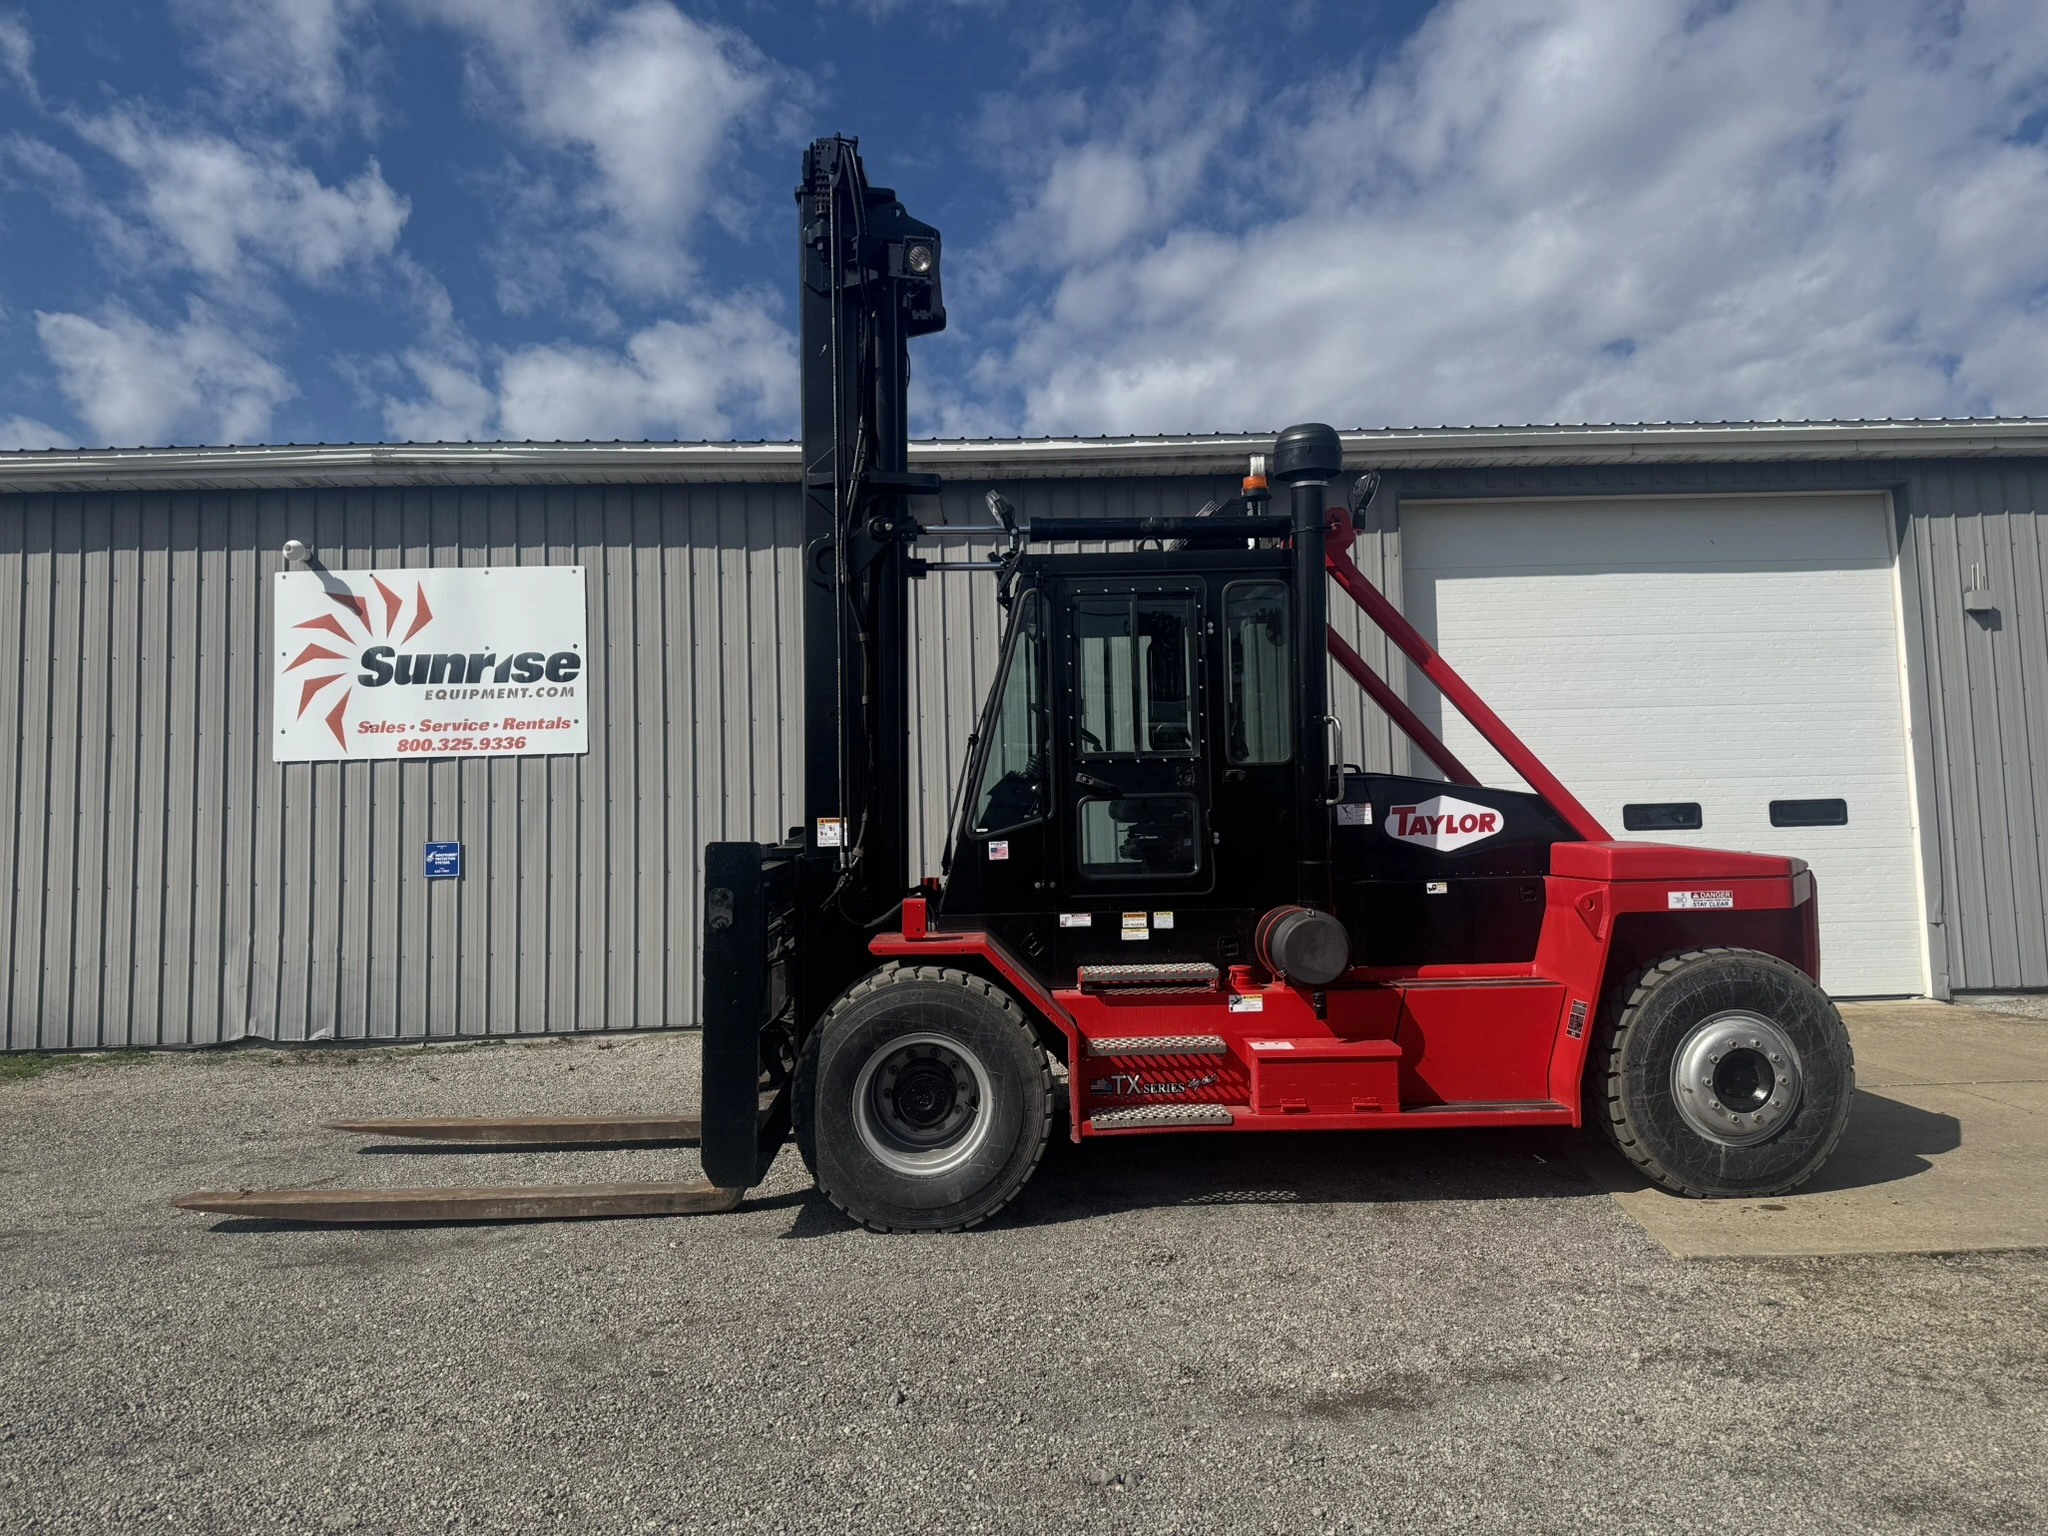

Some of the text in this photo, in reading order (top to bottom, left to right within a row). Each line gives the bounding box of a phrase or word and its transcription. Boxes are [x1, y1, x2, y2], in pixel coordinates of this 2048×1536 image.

[357, 646, 581, 687] Sunrise
[424, 686, 575, 701] EQUIPMENT.COM
[357, 716, 571, 734] Sales Service Rentals
[396, 736, 527, 753] 800.325.9336
[1392, 806, 1497, 836] TAYLOR
[1700, 891, 1731, 899] DANGER
[1111, 1075, 1141, 1094] TX
[1143, 1083, 1185, 1093] SERIES
